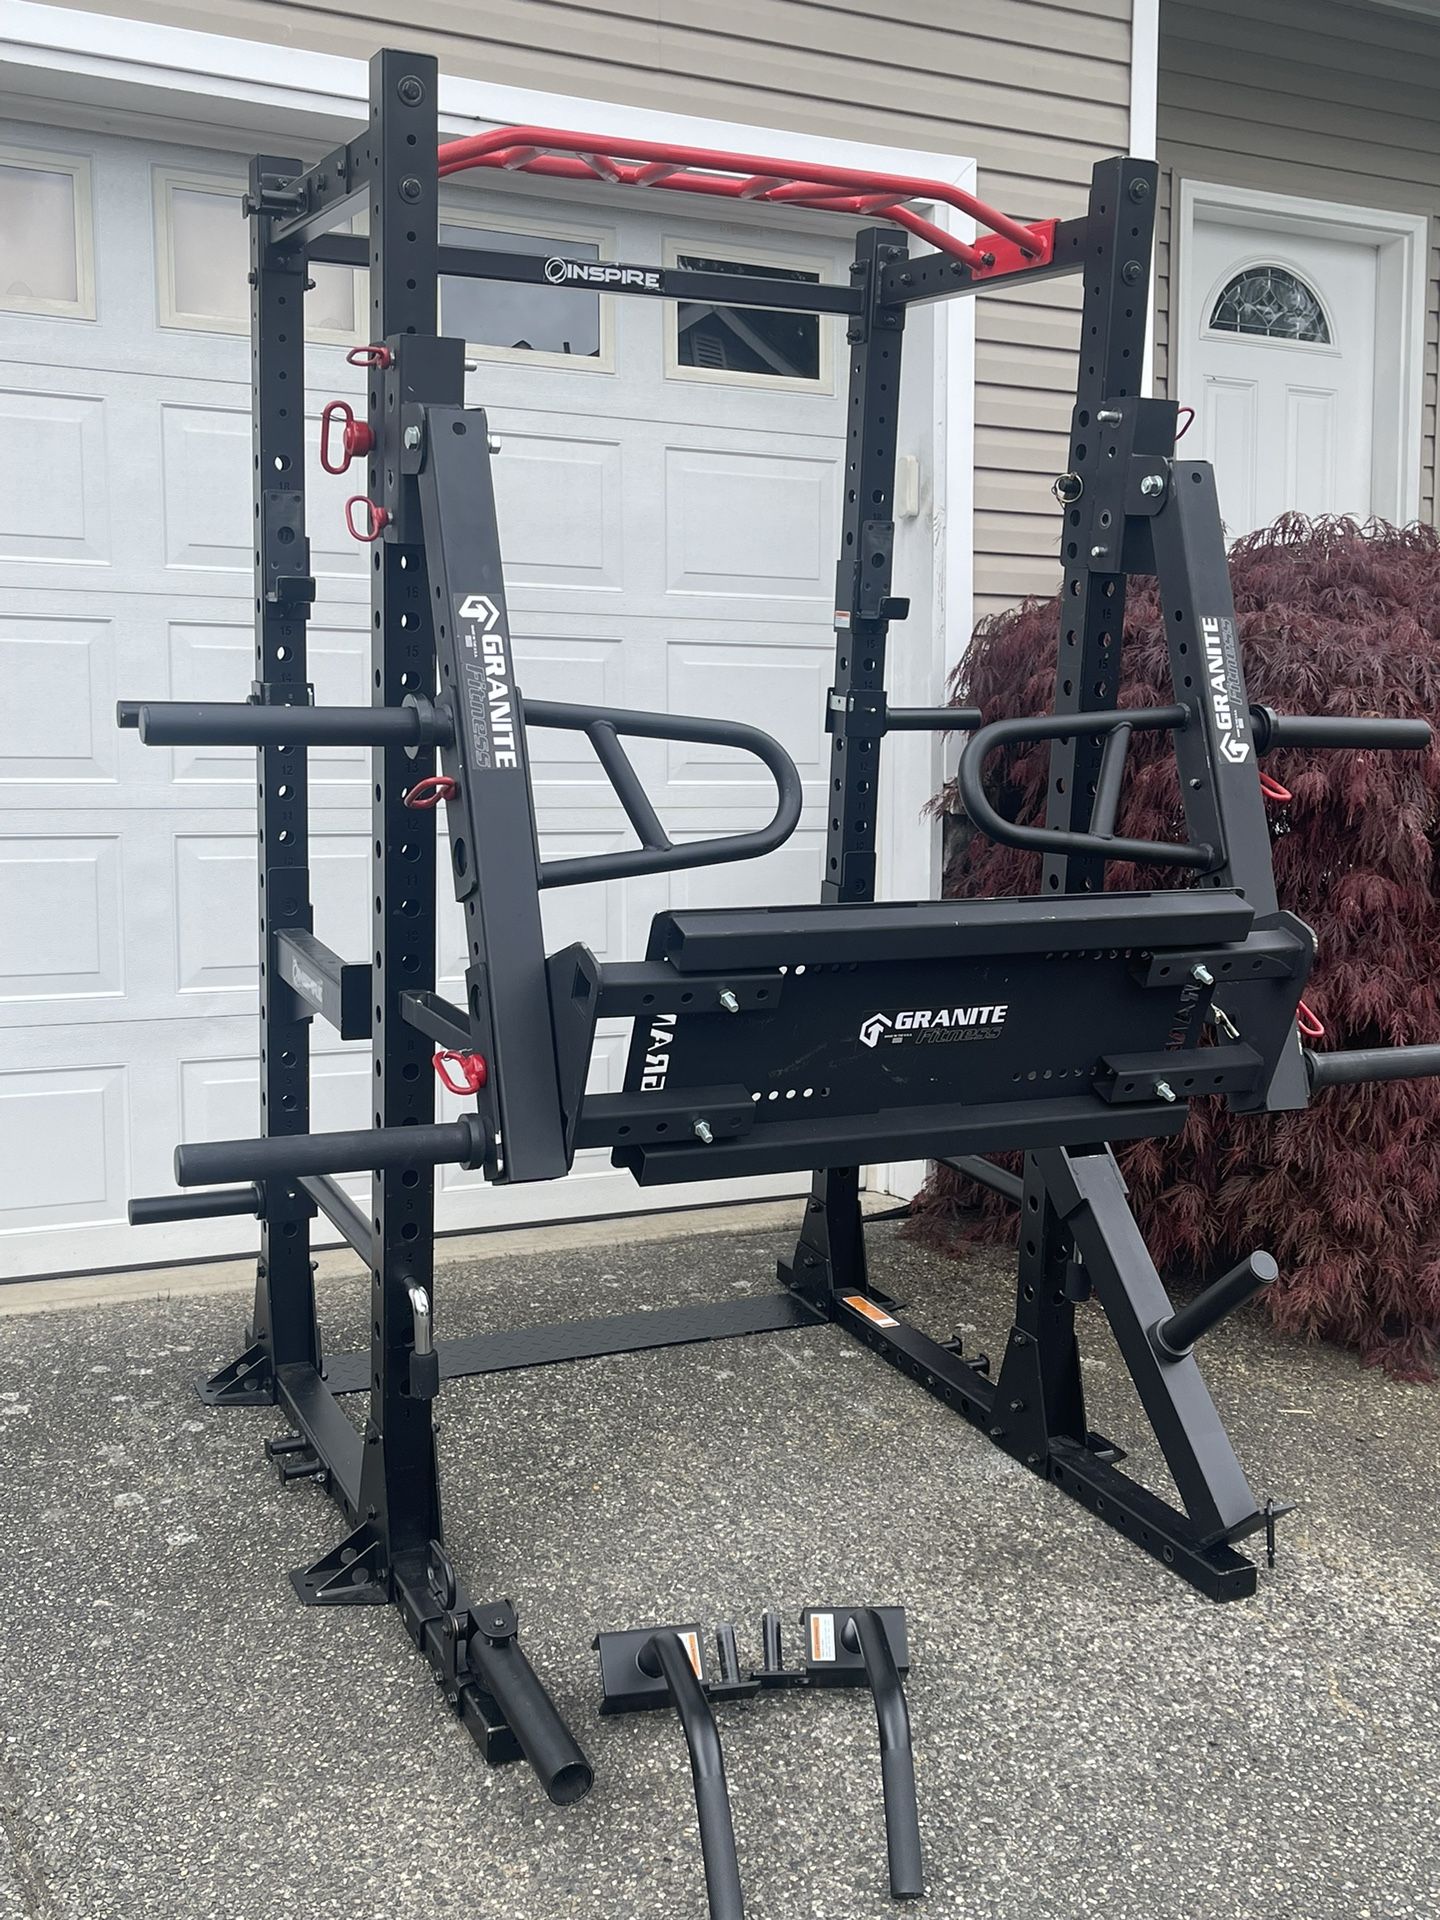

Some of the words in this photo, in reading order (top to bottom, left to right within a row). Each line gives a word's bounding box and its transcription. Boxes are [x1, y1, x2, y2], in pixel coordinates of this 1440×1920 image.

[567, 263, 660, 288] INSPIRE
[406, 645, 419, 658] 15
[1221, 617, 1243, 705] Fitness
[1202, 617, 1233, 730] GRANITE
[481, 634, 517, 768] GRANITE
[466, 663, 491, 768] Fitness
[282, 764, 294, 775] 12
[895, 1005, 1008, 1030] GRANITE
[915, 1027, 1003, 1044] Fitness
